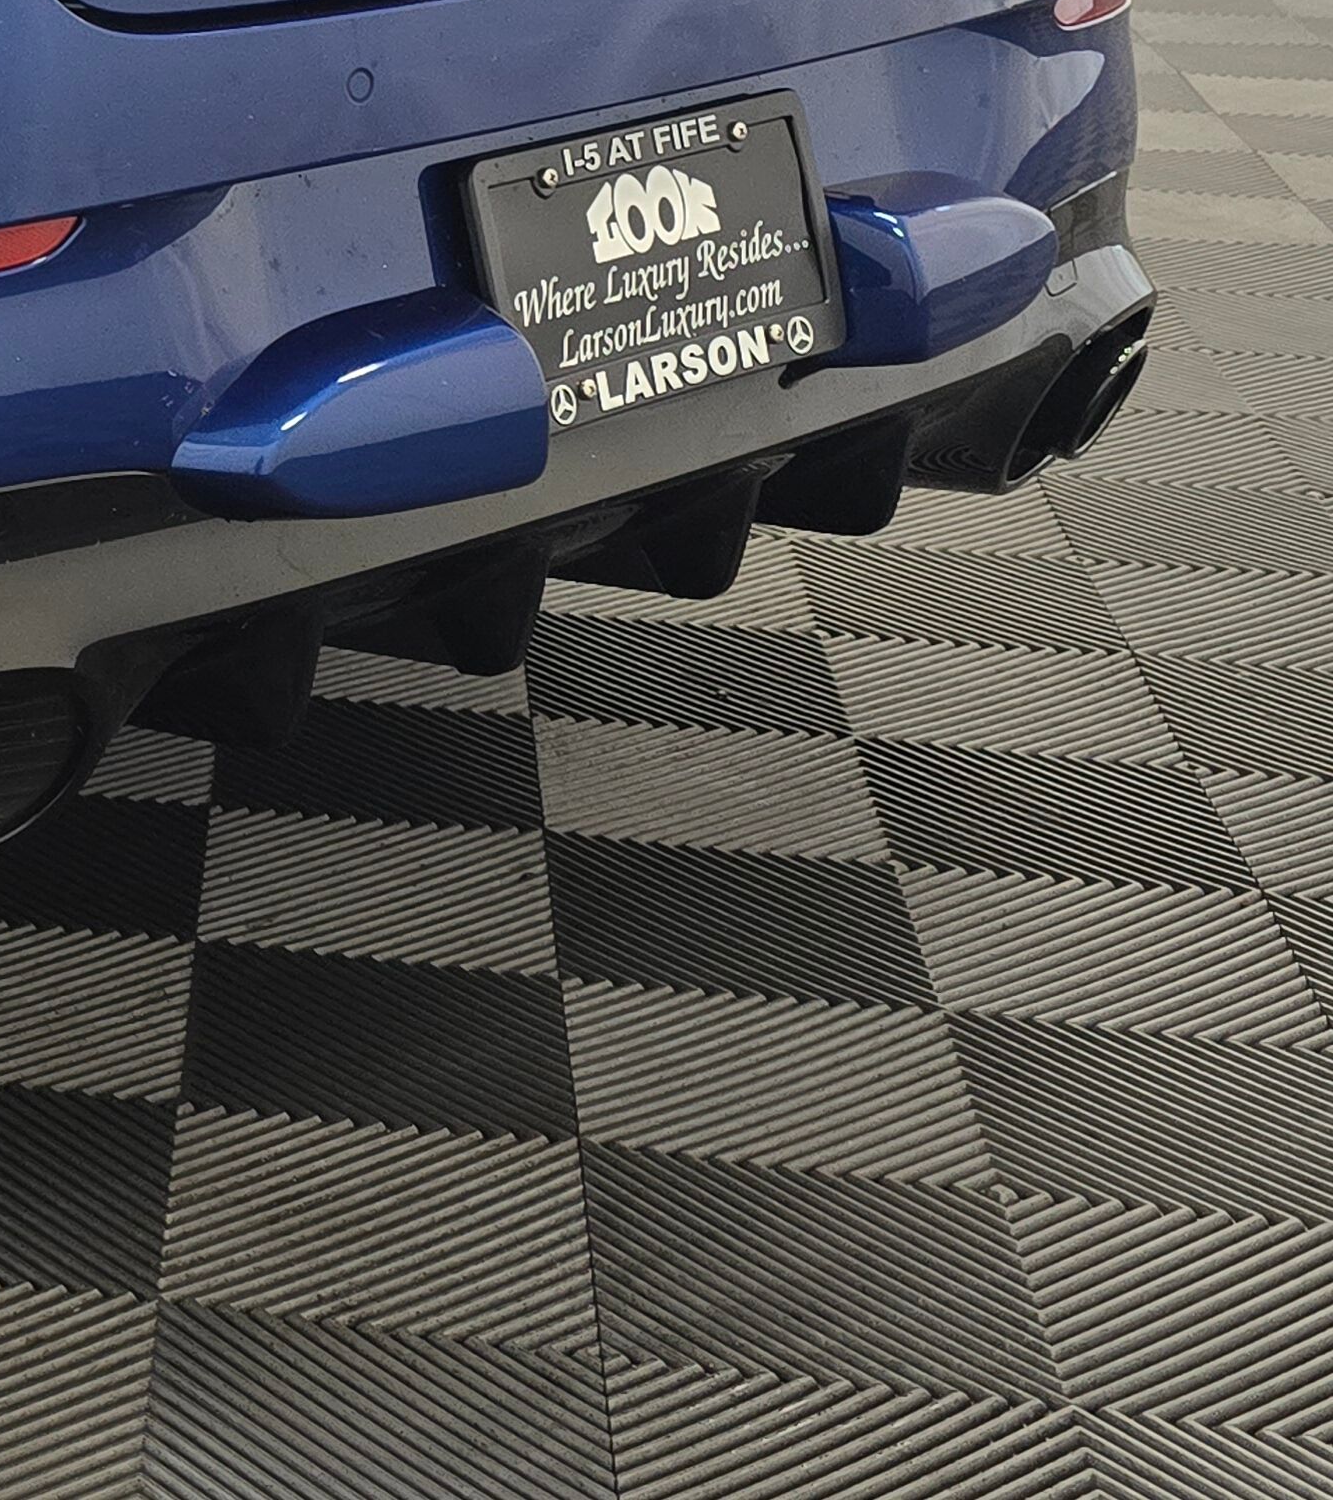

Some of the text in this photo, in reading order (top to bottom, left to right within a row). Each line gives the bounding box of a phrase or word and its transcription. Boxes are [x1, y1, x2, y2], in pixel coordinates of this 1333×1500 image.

[561, 114, 721, 177] I-5 AT FIFE
[586, 165, 721, 264] LOOK
[514, 220, 810, 328] Where Luxury Resides...
[559, 279, 784, 369] LarsonLuxury.com
[594, 324, 771, 413] LARSON
